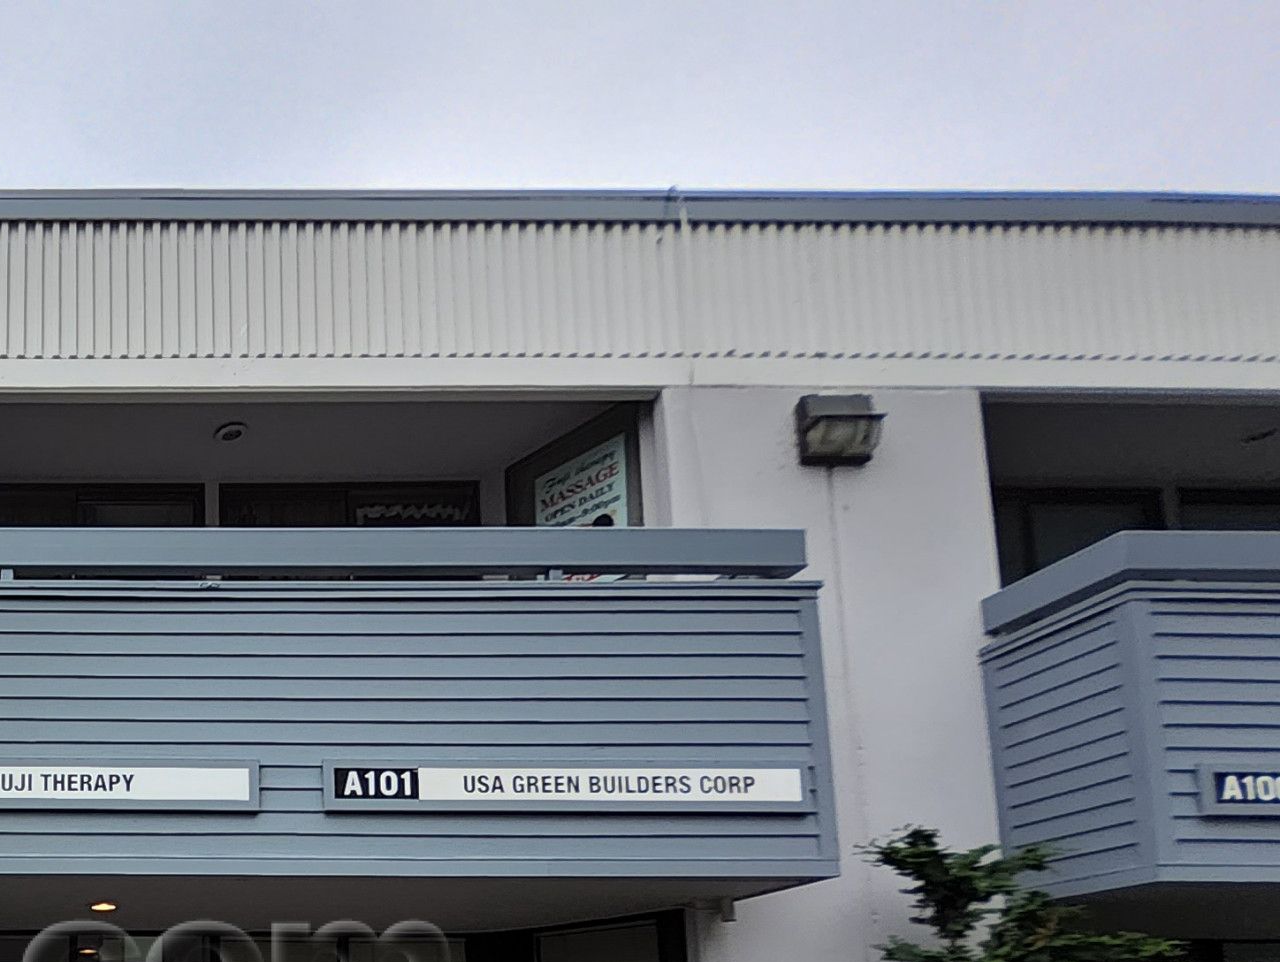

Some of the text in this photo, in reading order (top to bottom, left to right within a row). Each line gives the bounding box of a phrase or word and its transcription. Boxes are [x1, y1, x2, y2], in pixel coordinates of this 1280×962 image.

[540, 460, 620, 512] MASSAGE
[545, 481, 617, 522] OPEN DAILY
[40, 773, 135, 793] THERAPY
[343, 770, 412, 796] A101
[463, 774, 756, 794] USA GREEN BUILDERS CORP
